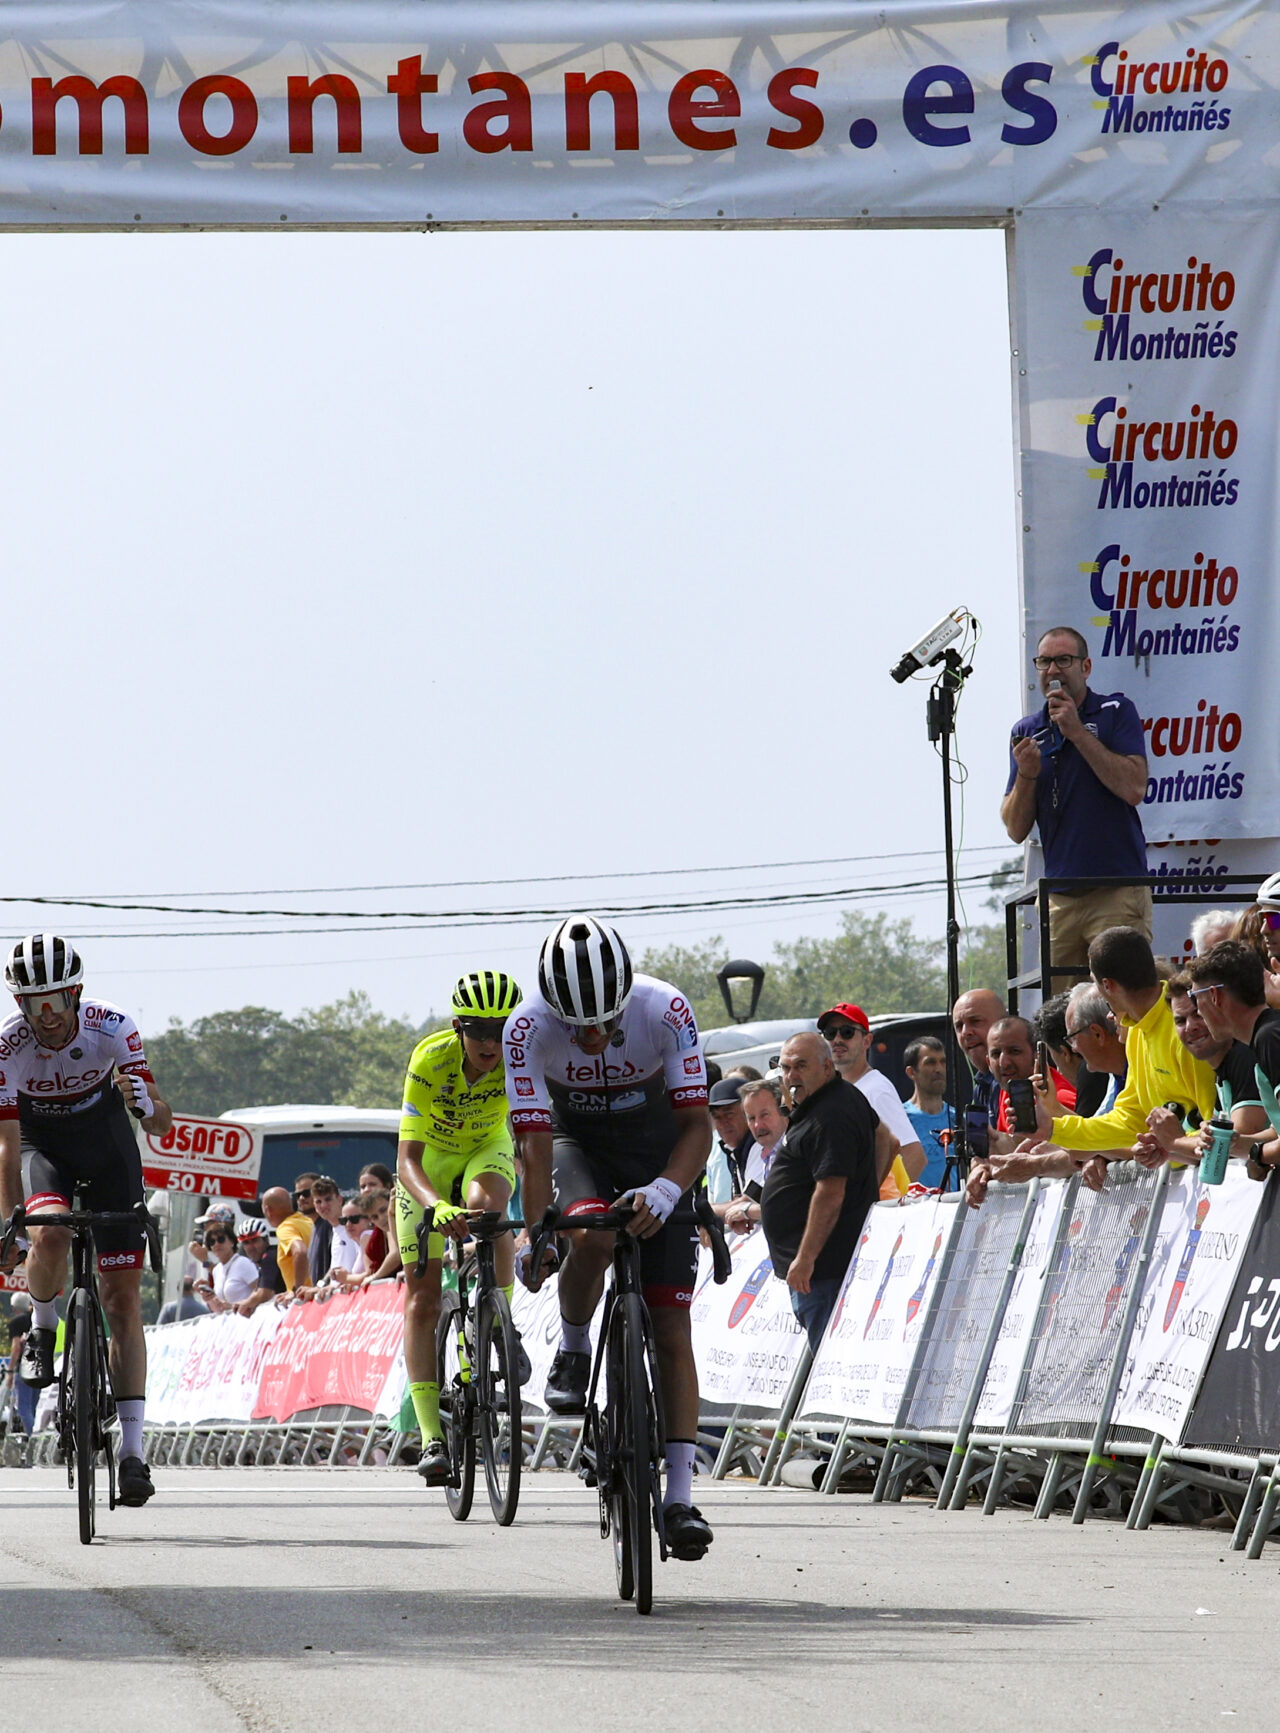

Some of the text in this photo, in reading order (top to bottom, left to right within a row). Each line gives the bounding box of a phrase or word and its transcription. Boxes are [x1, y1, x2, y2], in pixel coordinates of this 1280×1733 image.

[1090, 42, 1229, 97] Circuito
[1101, 96, 1231, 133] Montañés
[1082, 248, 1235, 315] Circuito
[1094, 313, 1238, 361] Montañés
[1086, 396, 1238, 464] Circuito
[1097, 461, 1240, 509] Montañés
[1090, 544, 1238, 611] Circuito
[1102, 609, 1241, 657] Montañés
[1140, 699, 1242, 757] rcuito
[1143, 762, 1245, 804] ontañés
[569, 1092, 607, 1105] ON
[167, 1172, 222, 1195] 50 M
